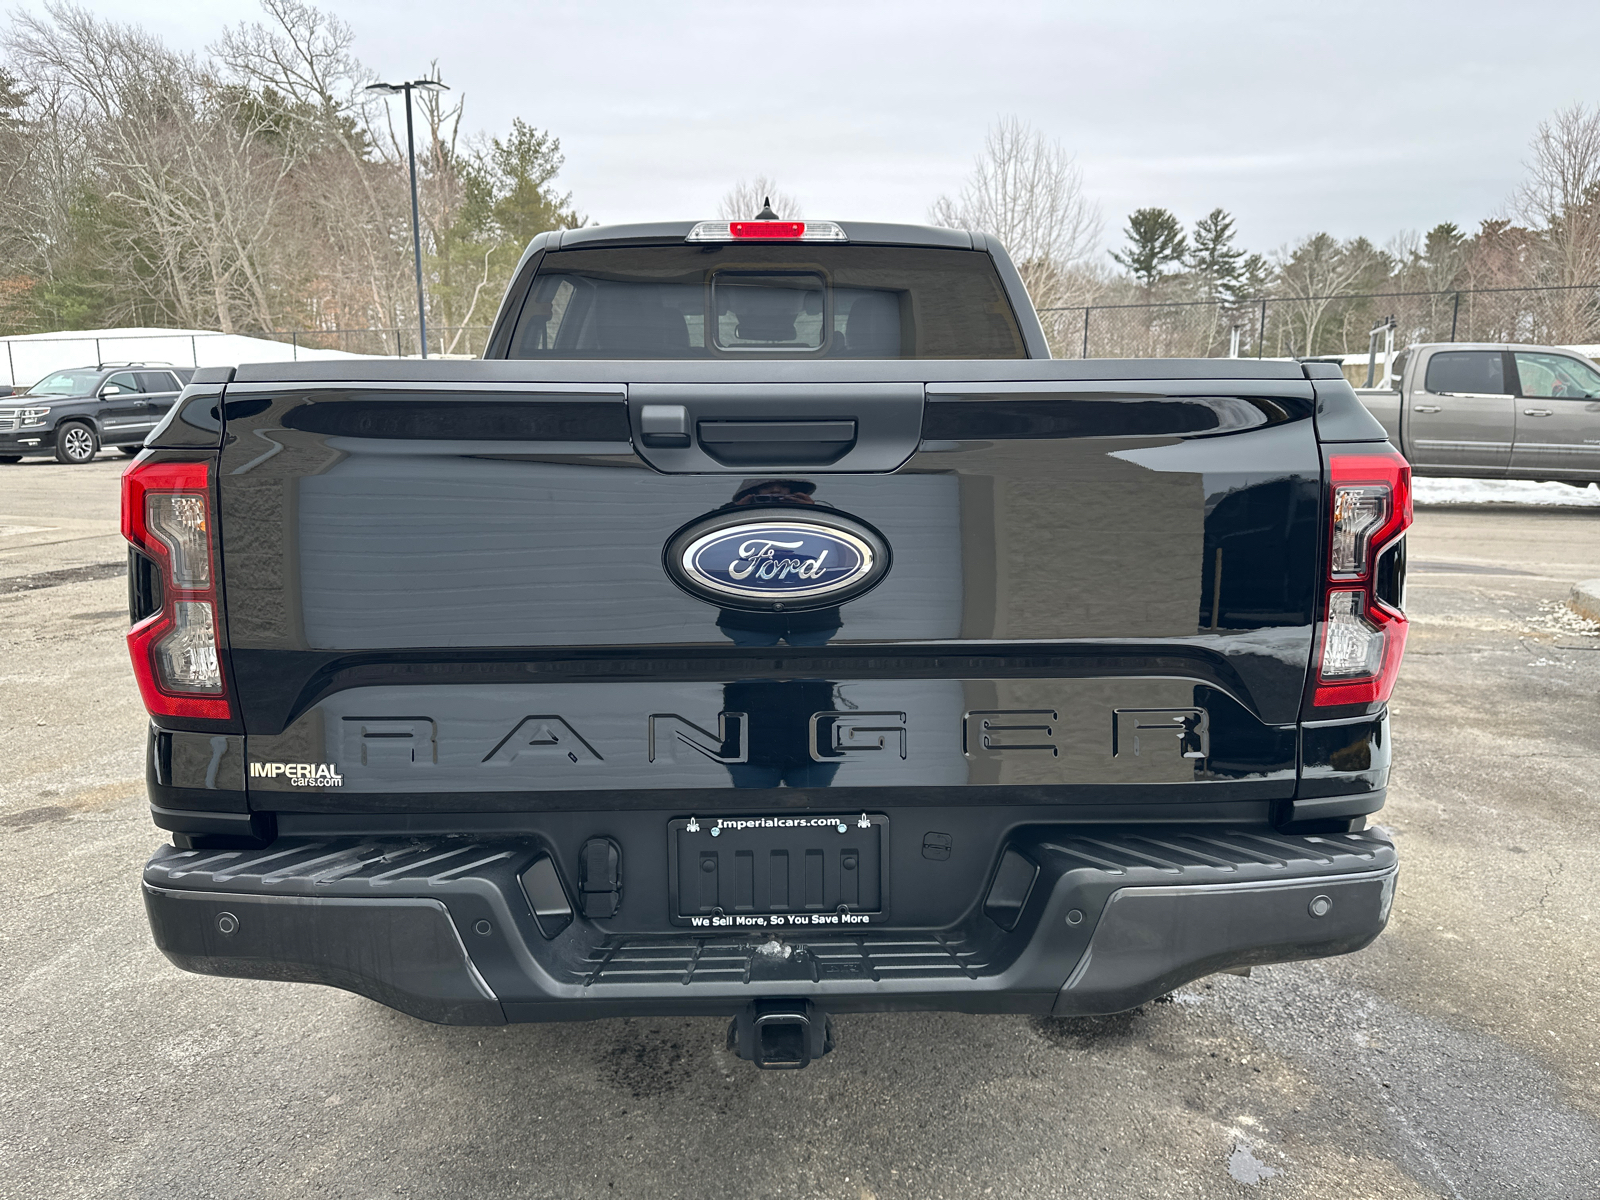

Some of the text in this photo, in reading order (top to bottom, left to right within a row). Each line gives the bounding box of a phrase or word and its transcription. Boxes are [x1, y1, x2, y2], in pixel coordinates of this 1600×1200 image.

[728, 539, 829, 580] Ford
[340, 706, 1210, 765] RANGER
[250, 762, 342, 778] IMPERIAL
[291, 778, 342, 787] cars.com
[717, 817, 841, 830] Imperialcars.com
[692, 914, 870, 927] We Sell More, So You Save More
